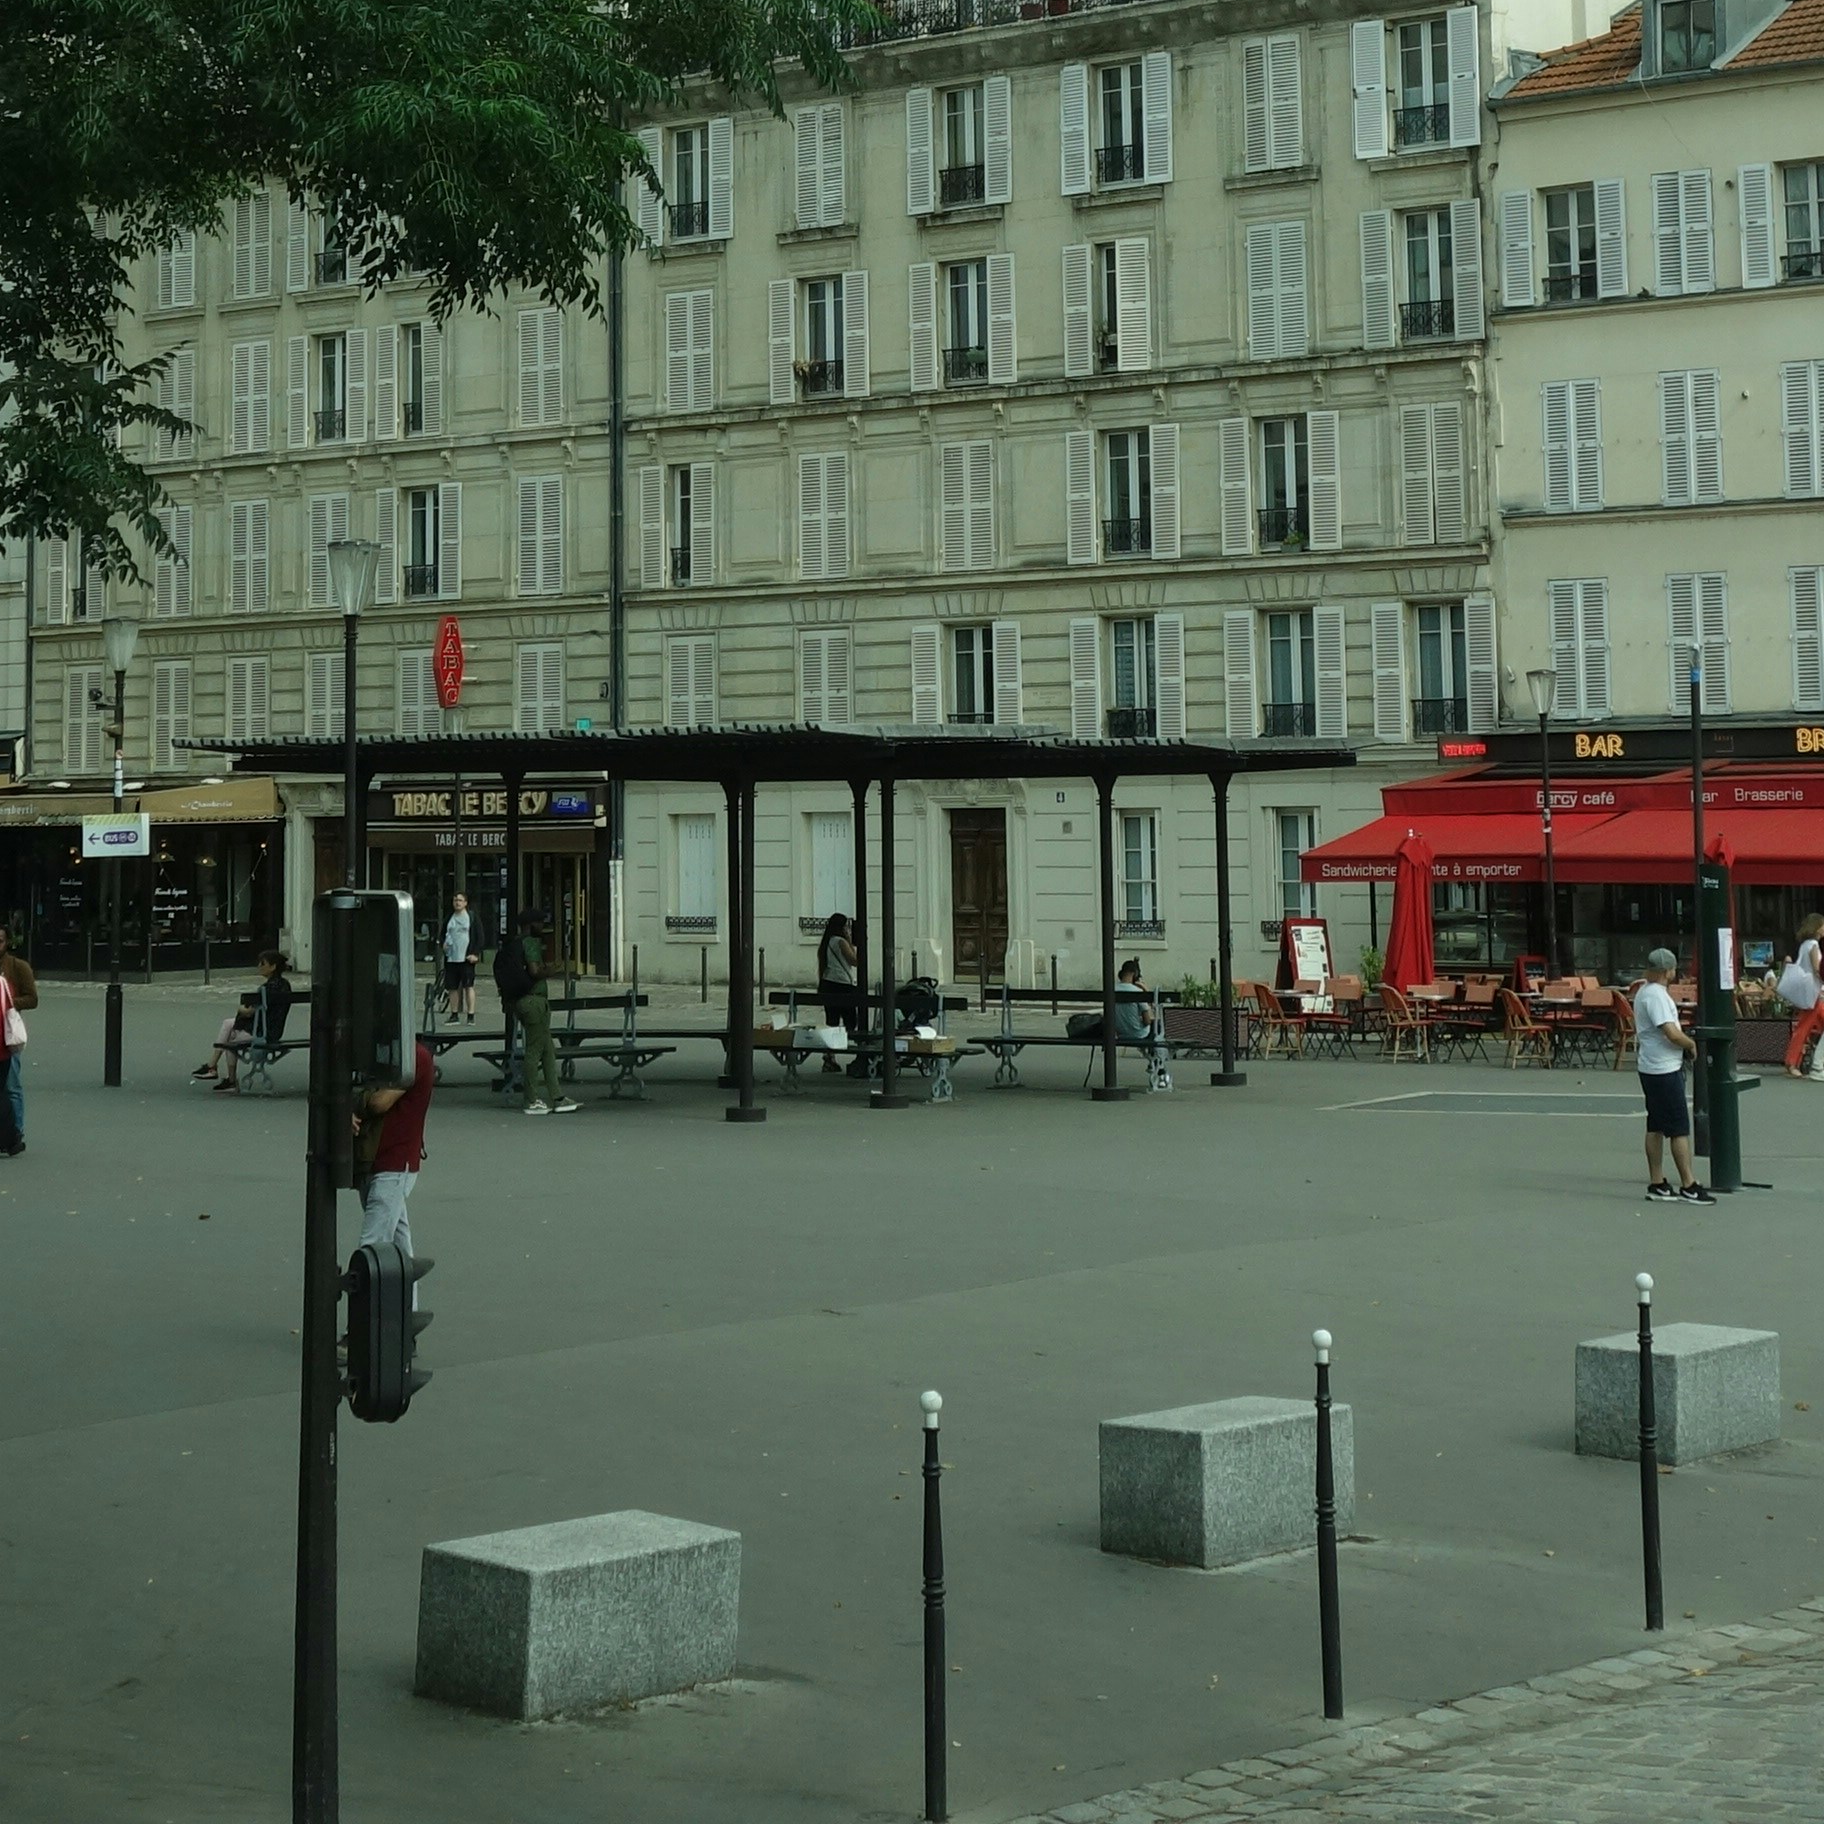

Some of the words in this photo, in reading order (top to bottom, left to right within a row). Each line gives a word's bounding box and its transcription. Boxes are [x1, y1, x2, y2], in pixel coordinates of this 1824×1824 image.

[442, 622, 460, 702] TABAC
[1575, 733, 1625, 758] BAR
[1582, 790, 1615, 805] café
[1734, 787, 1804, 802] Brasserie
[392, 792, 452, 817] TABAC
[468, 834, 478, 846] LE
[1321, 862, 1397, 877] Sandwicherie
[1453, 862, 1461, 876] à
[1465, 864, 1522, 878] emporter
